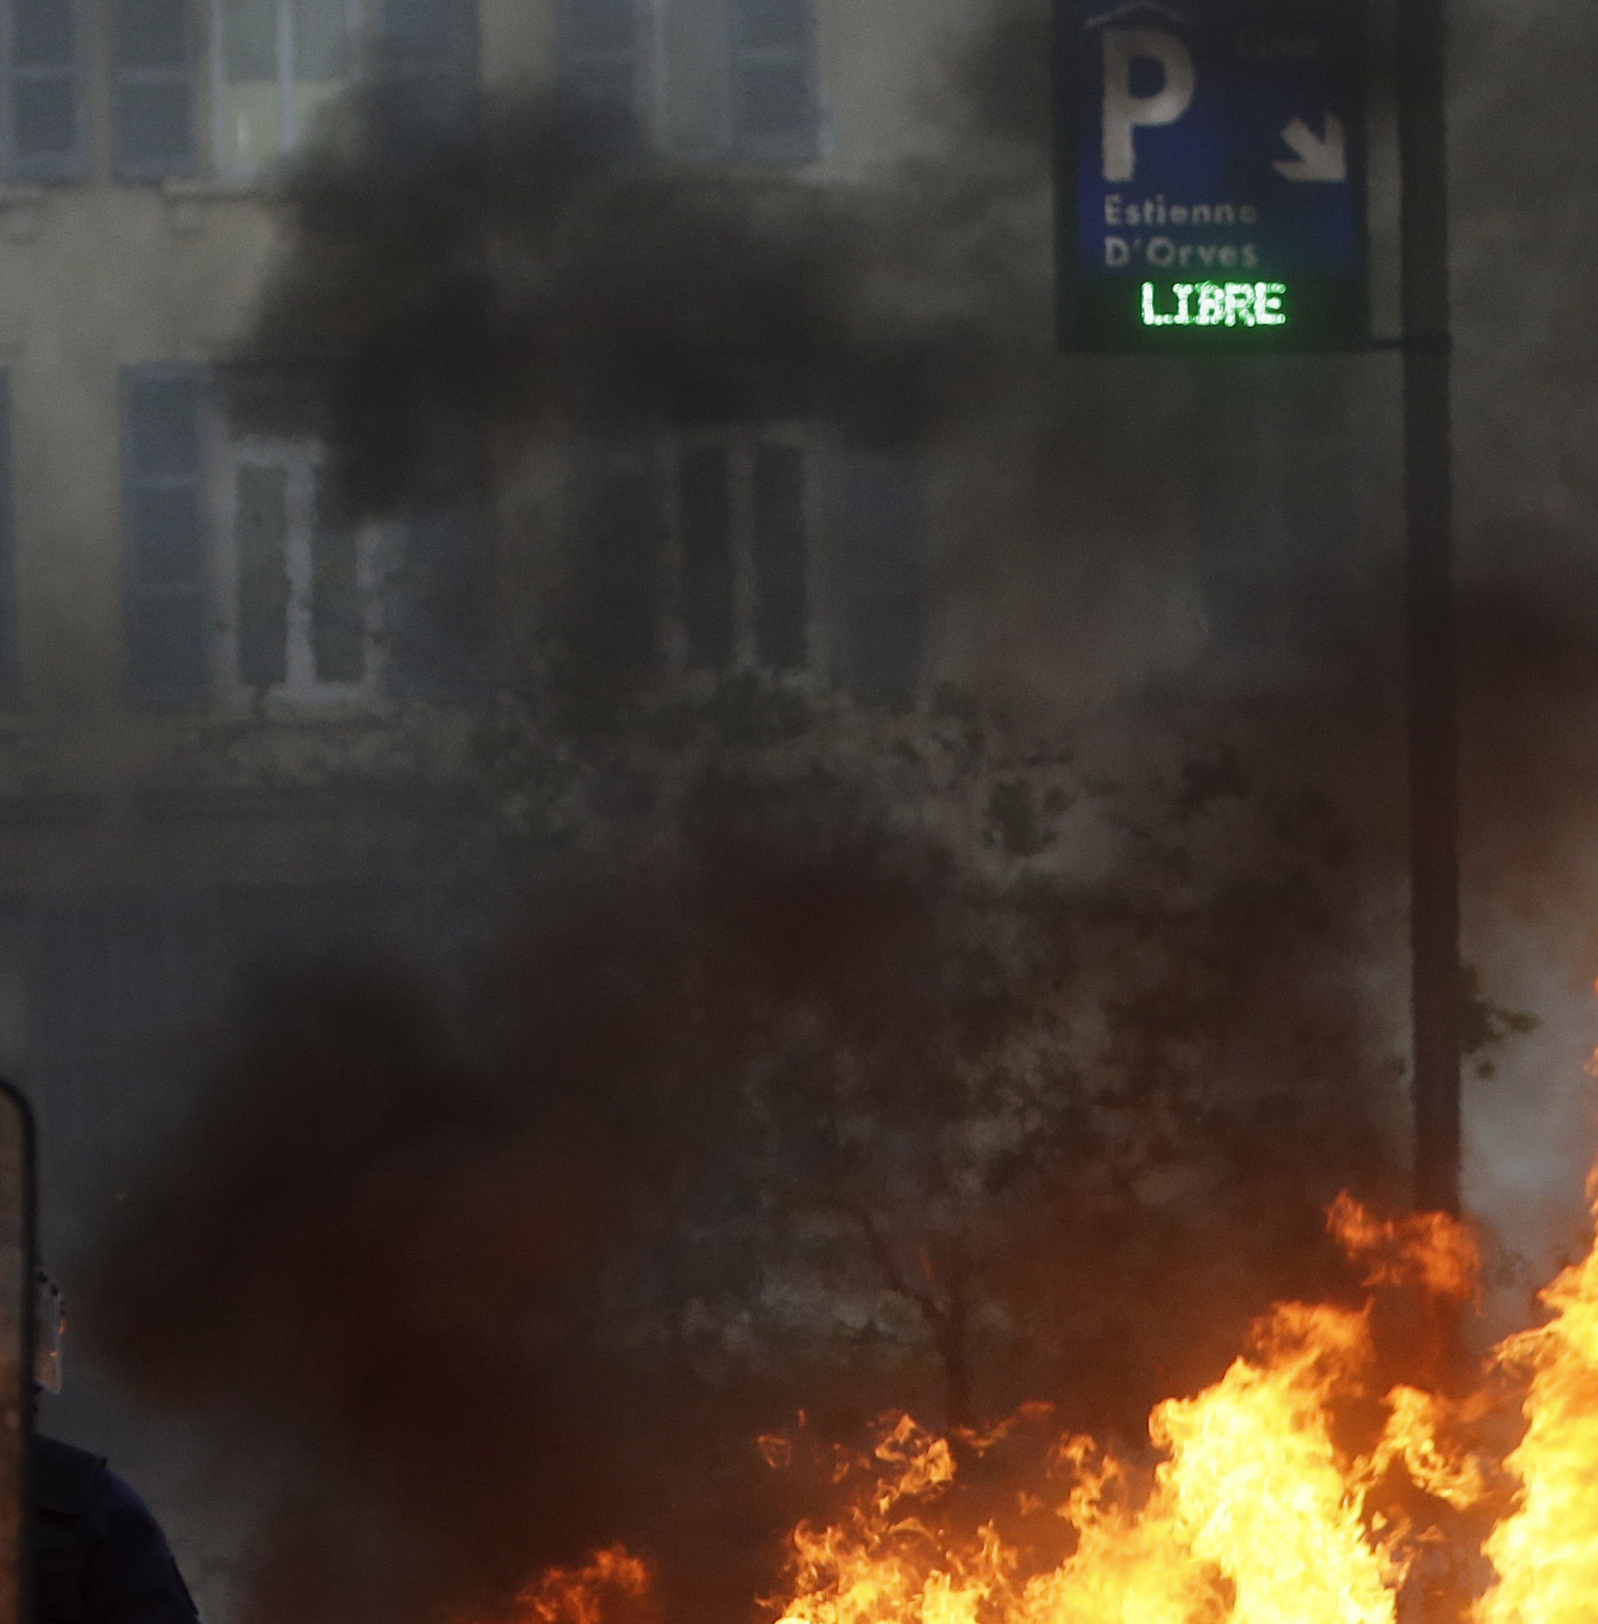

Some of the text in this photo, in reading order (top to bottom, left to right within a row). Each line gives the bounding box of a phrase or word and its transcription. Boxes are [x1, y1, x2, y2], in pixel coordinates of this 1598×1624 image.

[1101, 29, 1196, 182] P
[1104, 194, 1259, 227] Estienne
[1104, 235, 1259, 268] D'Orves
[1141, 281, 1287, 327] LIBRE
